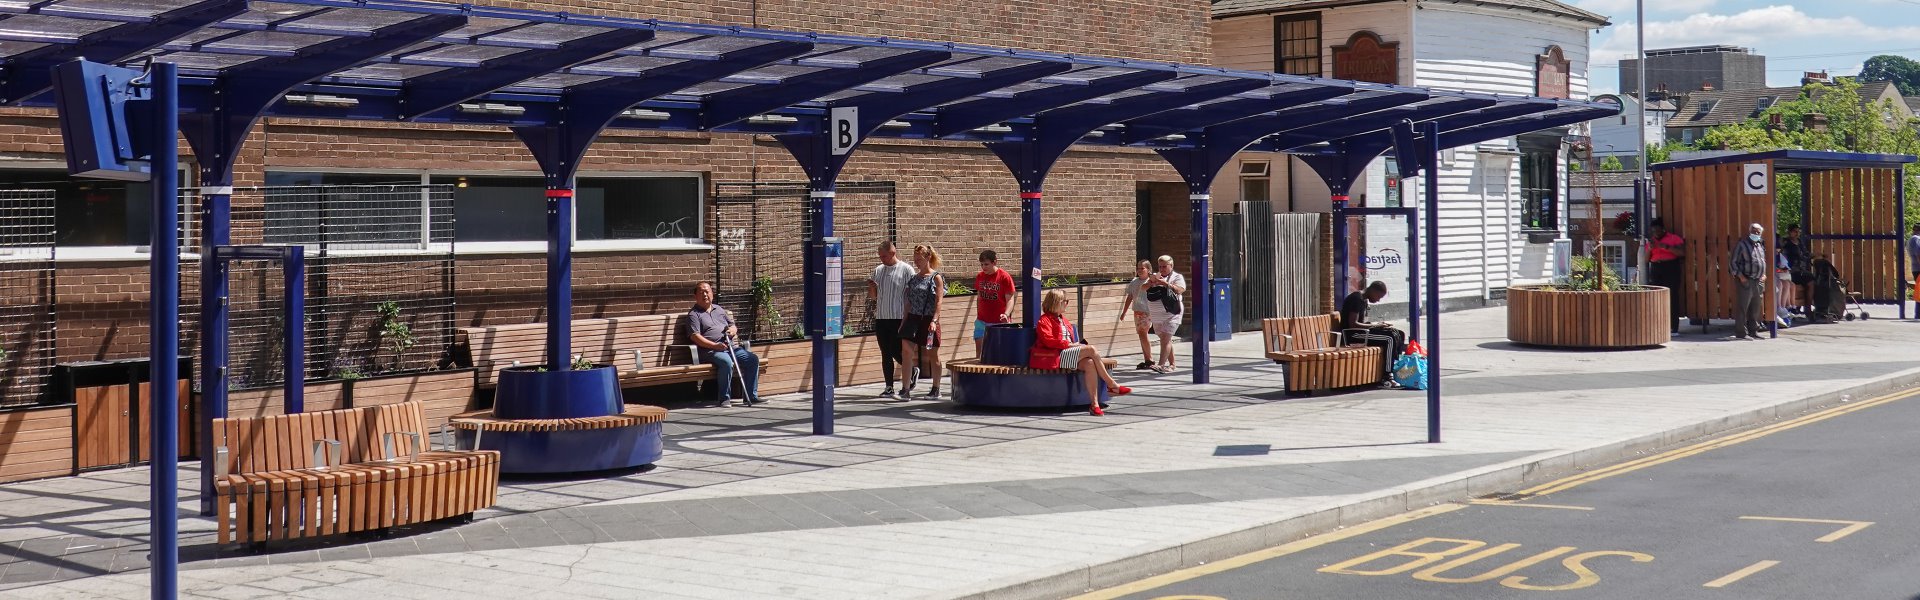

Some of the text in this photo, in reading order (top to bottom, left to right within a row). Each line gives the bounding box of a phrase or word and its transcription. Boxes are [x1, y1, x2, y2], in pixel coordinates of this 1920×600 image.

[1342, 58, 1390, 75] TRUMAN
[838, 119, 852, 149] B
[1747, 171, 1764, 190] C
[1316, 537, 1655, 591] BUS
